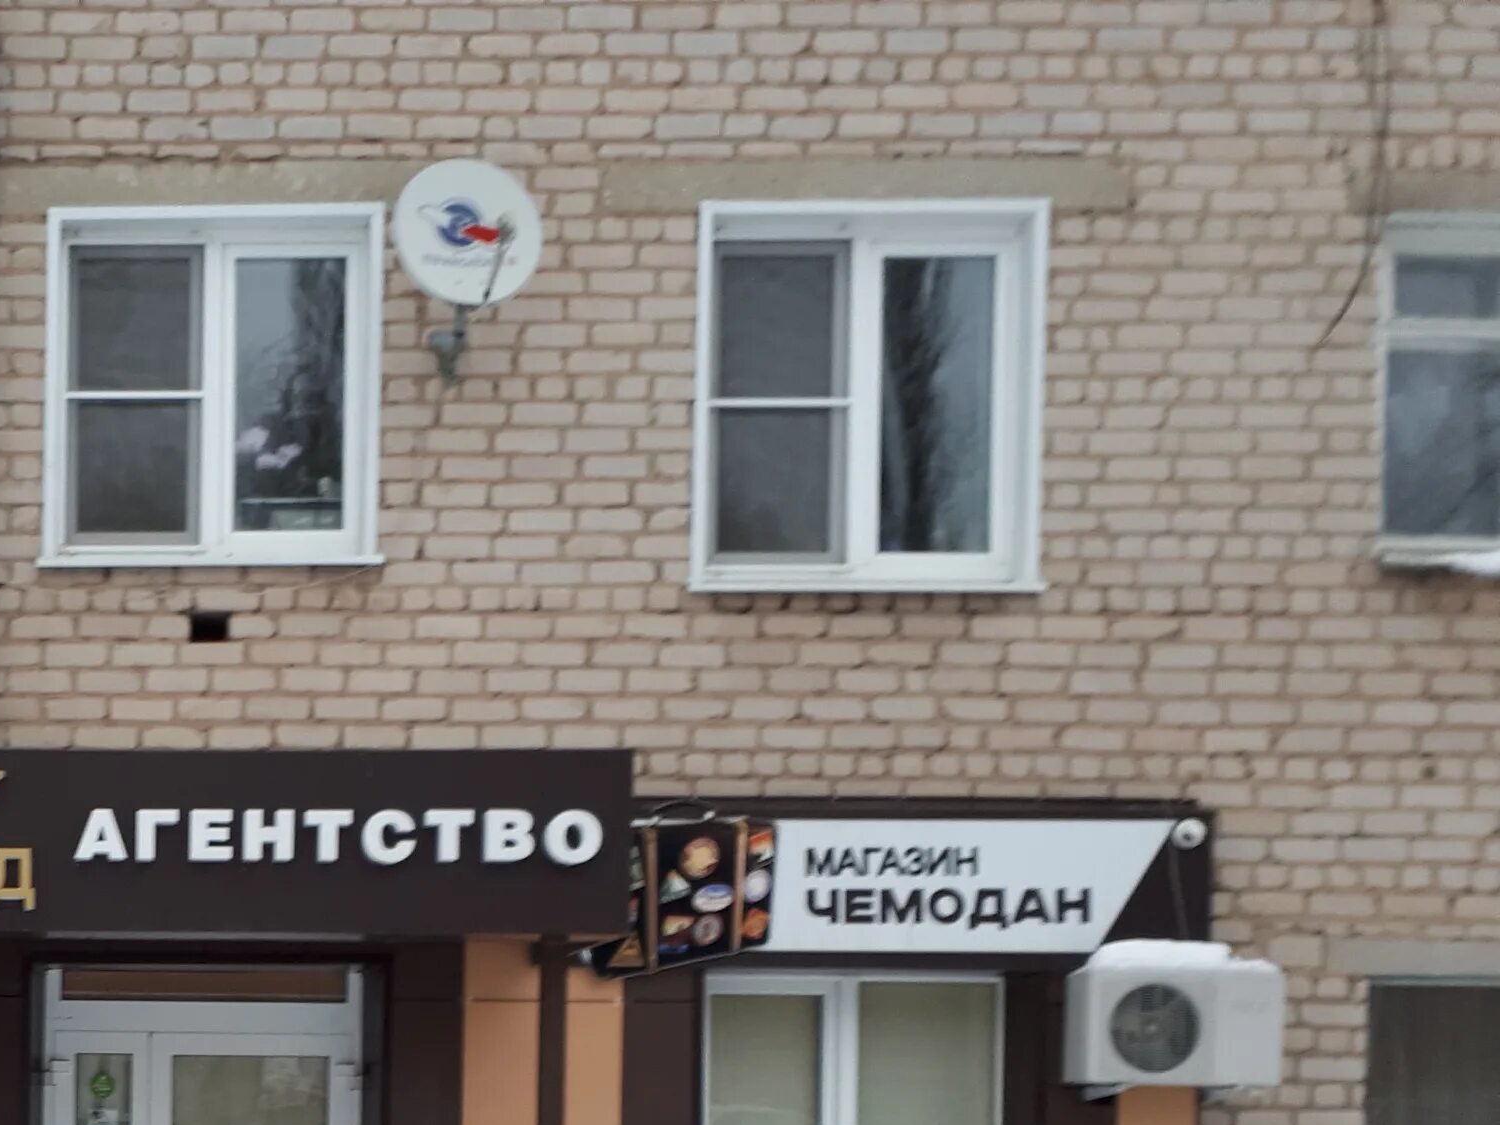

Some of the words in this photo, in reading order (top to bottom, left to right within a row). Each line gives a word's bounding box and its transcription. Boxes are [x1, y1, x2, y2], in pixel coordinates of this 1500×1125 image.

[73, 807, 604, 866] АГЕНТСТВО
[805, 846, 980, 877] МАГАЗИН
[806, 887, 1092, 930] ЧЕМОДАН
